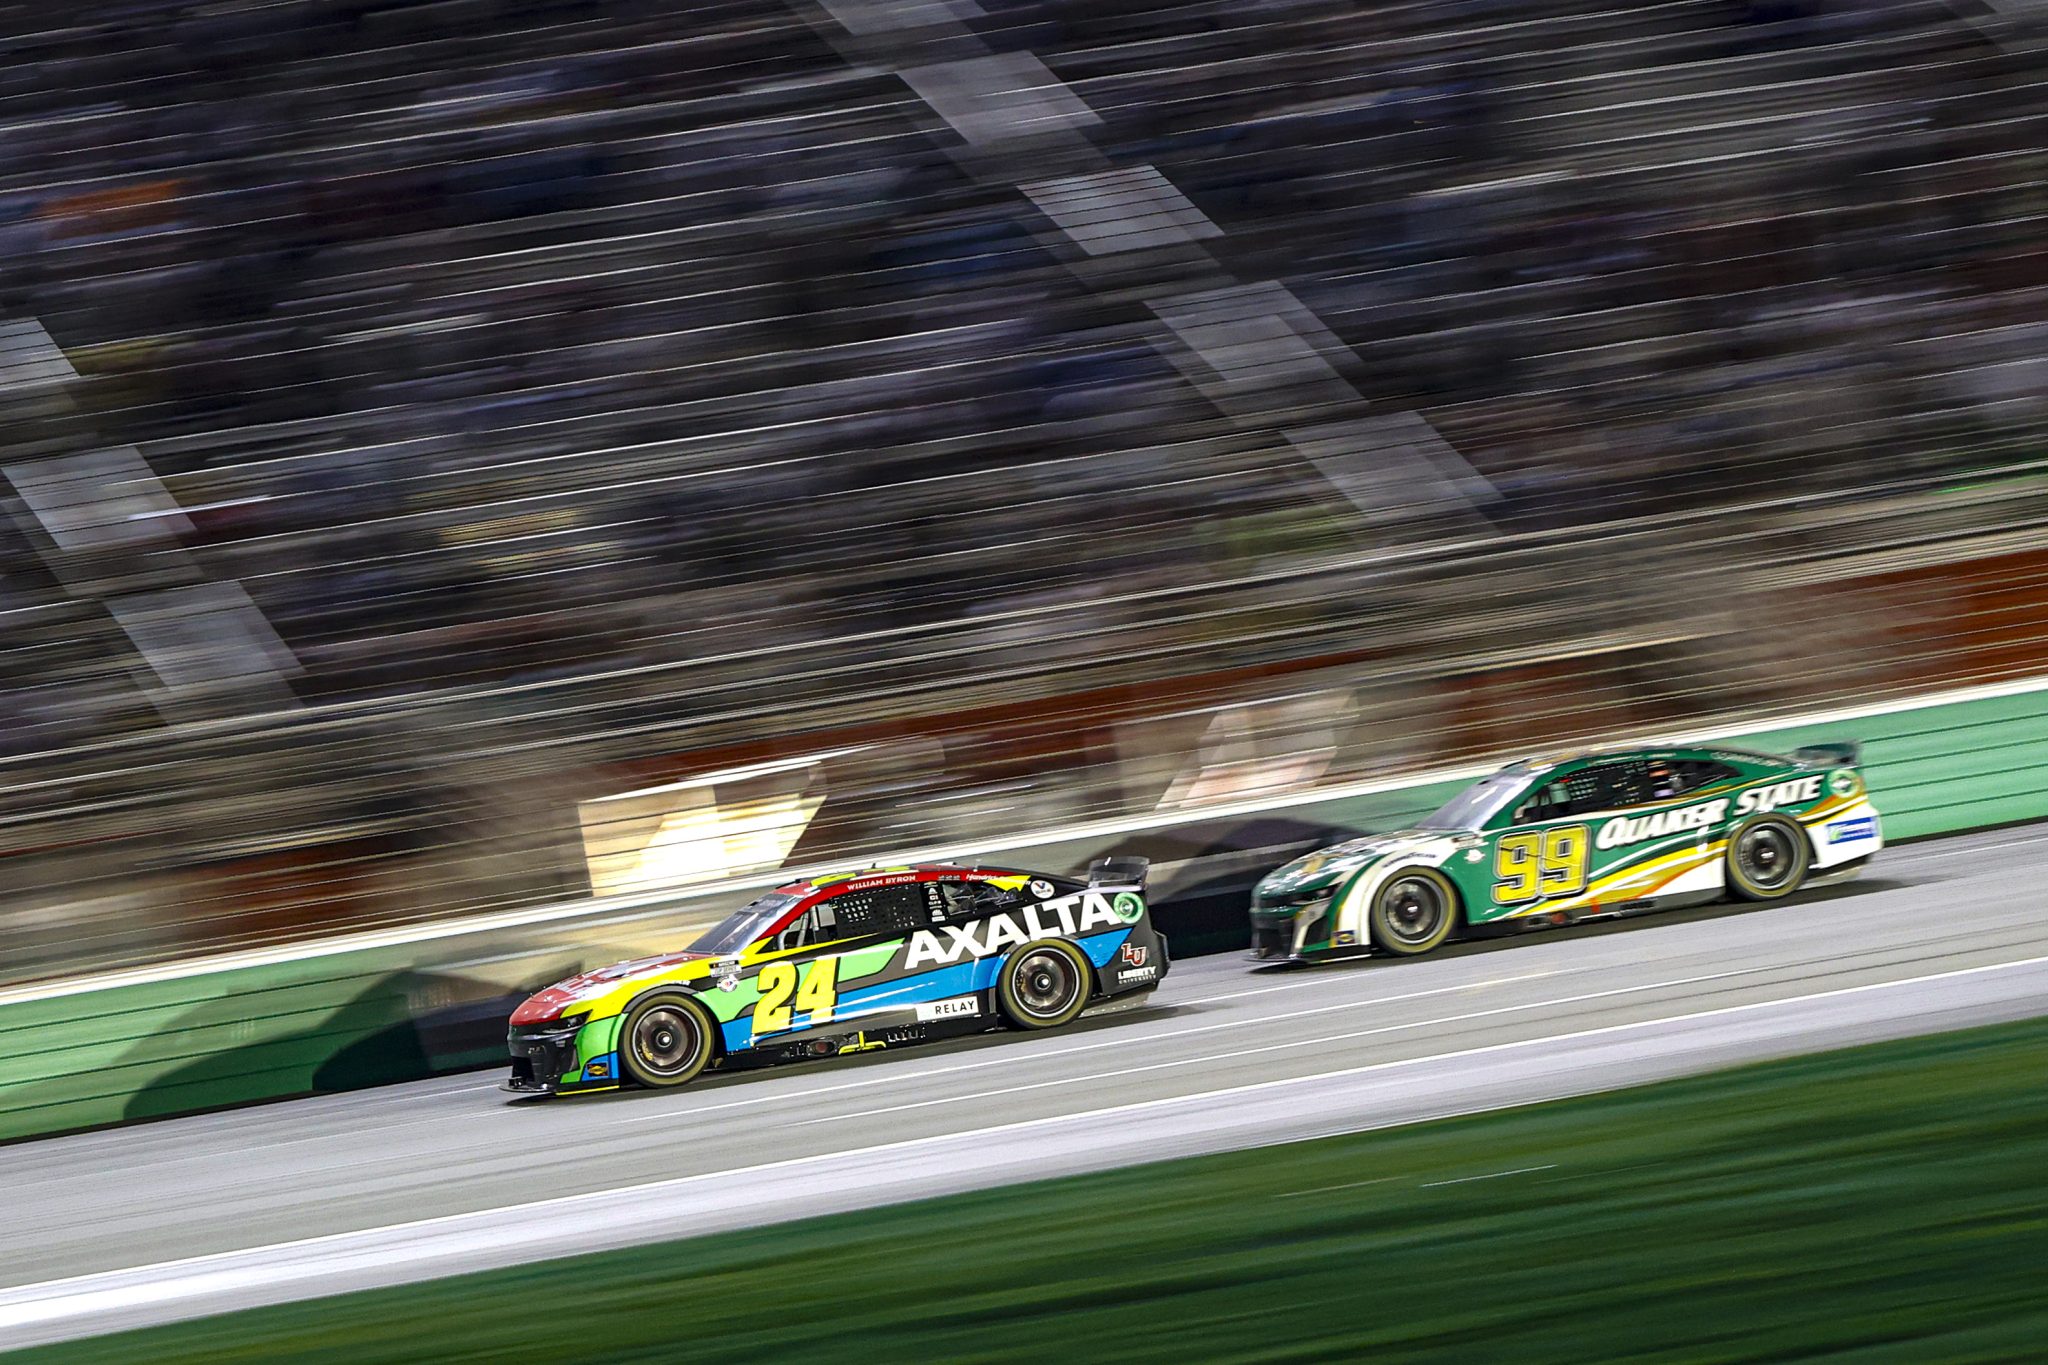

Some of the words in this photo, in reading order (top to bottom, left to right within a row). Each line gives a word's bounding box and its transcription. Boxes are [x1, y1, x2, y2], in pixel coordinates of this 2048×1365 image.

[1596, 798, 1729, 850] QUAKER
[1734, 775, 1825, 817] STATE
[1491, 827, 1591, 906] 99
[847, 879, 883, 891] WILLIAM
[885, 875, 916, 884] BYRON
[905, 893, 1120, 969] AXALTA
[1121, 942, 1147, 967] LU
[1118, 966, 1156, 979] LIBERTY
[1118, 975, 1157, 984] UNIVERSITY
[752, 956, 838, 1035] 24
[935, 1000, 974, 1014] RELAY
